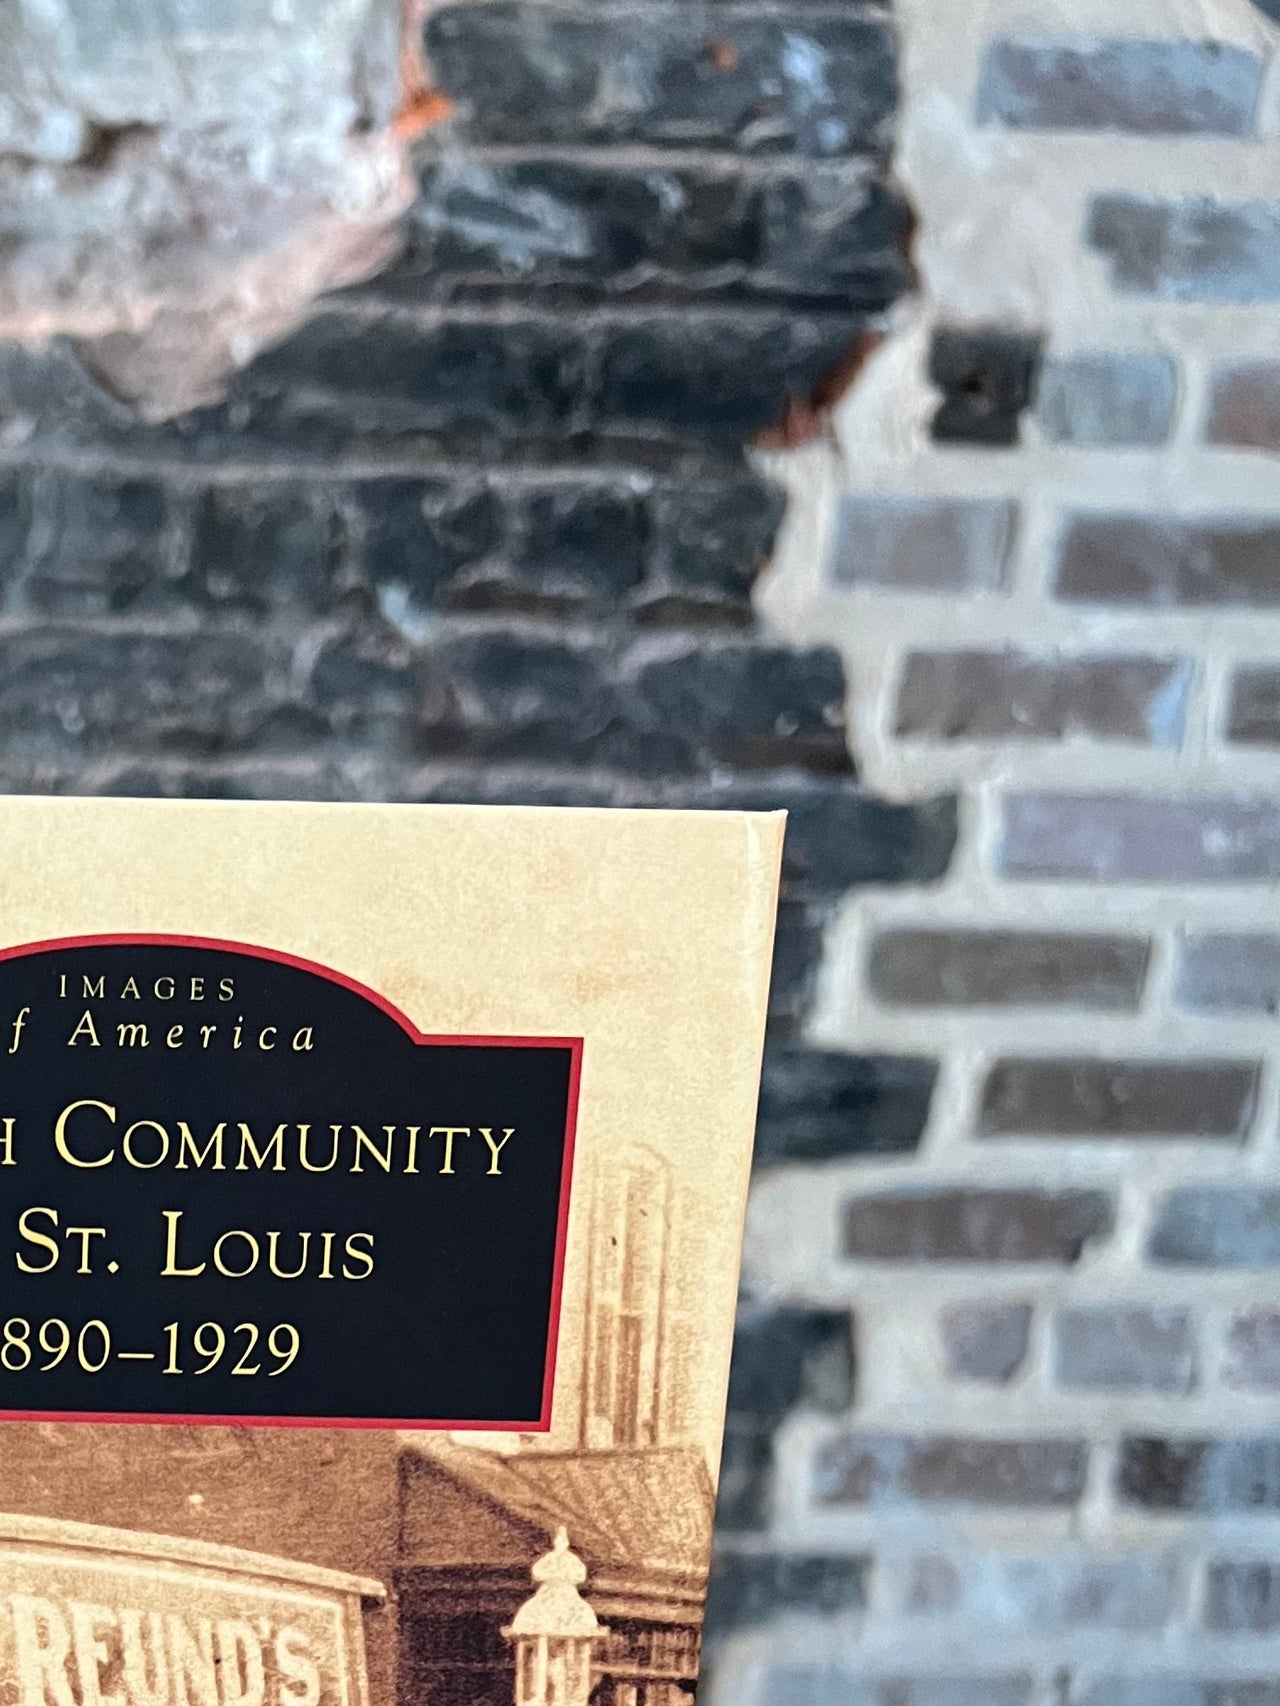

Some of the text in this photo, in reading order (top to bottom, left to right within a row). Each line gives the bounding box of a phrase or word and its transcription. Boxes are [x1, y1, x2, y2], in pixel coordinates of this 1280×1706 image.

[58, 974, 235, 1001] IMAGES
[67, 1009, 315, 1052] America
[54, 1099, 517, 1176] COMMUNITY
[15, 1206, 121, 1275] ST.
[160, 1210, 376, 1280] LOUIS
